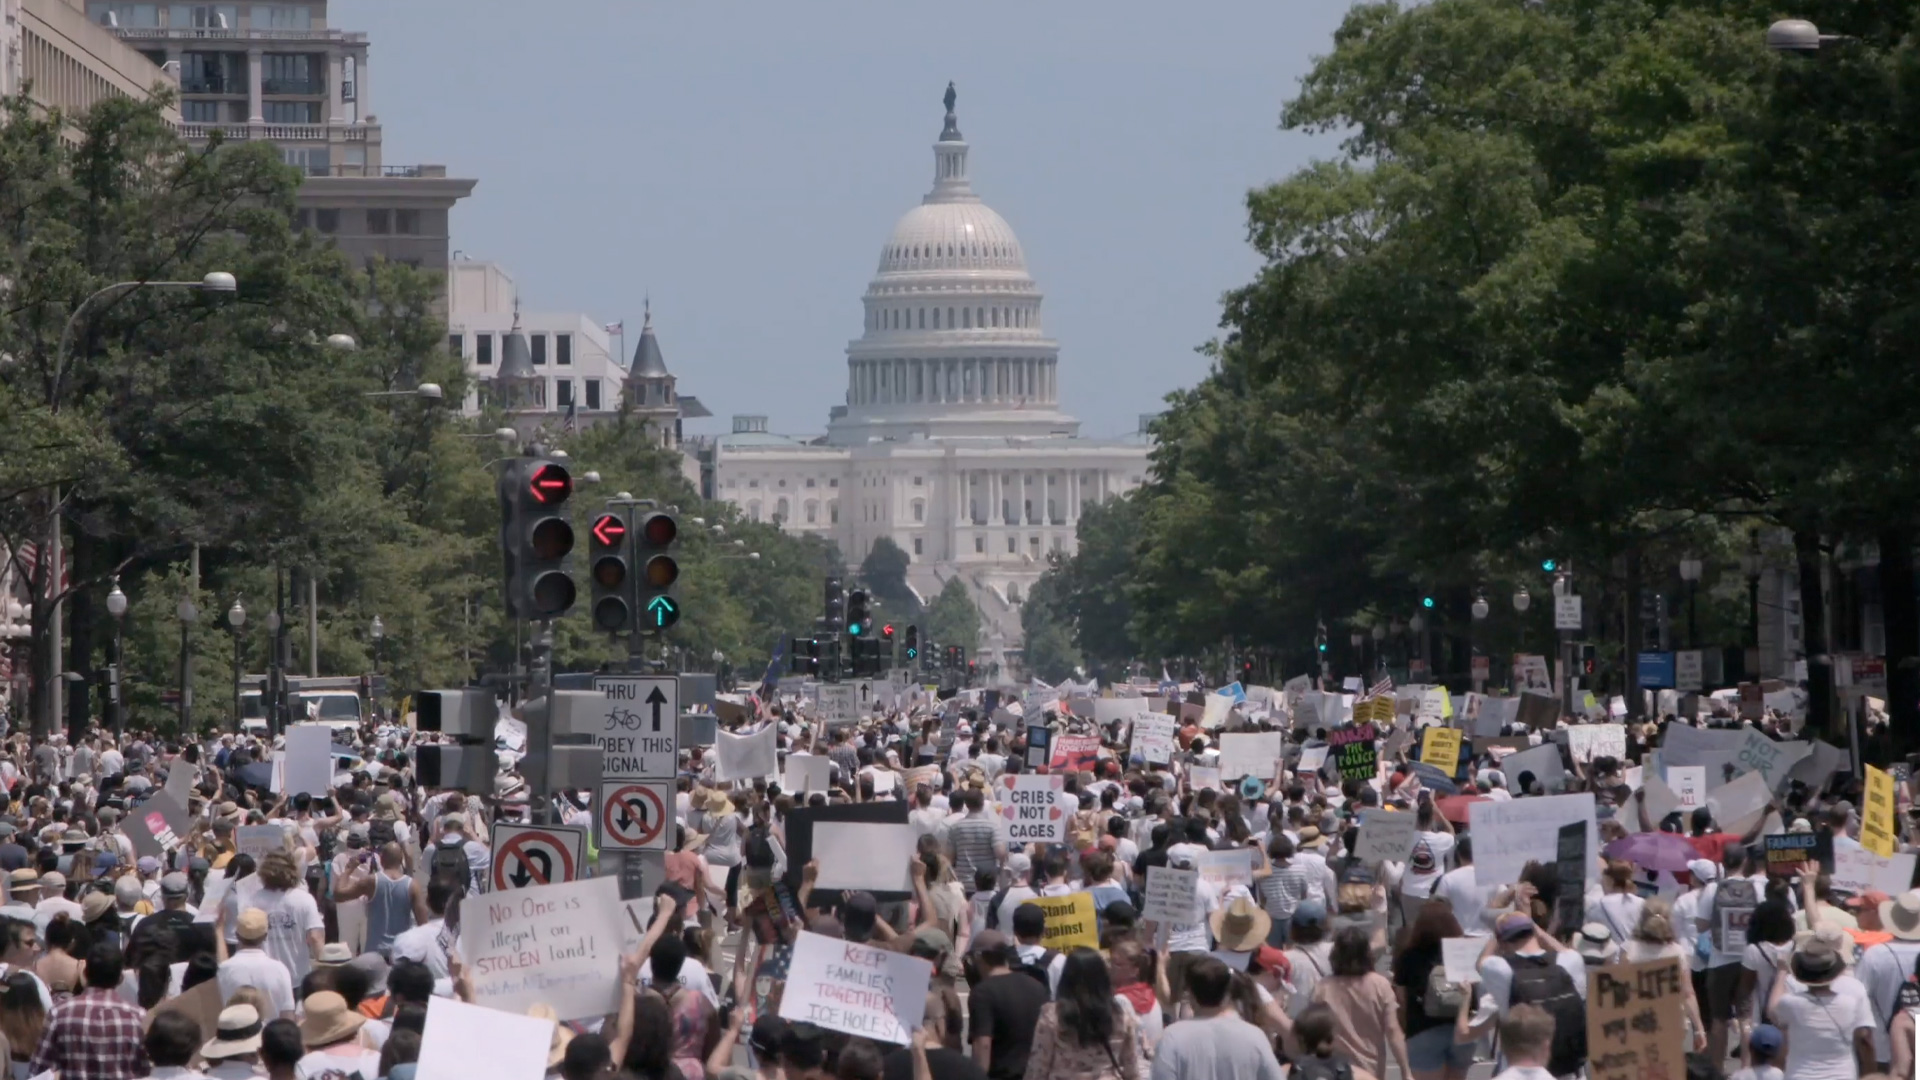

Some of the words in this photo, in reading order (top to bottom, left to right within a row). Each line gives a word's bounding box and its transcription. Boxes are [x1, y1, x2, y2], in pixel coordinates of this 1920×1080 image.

[598, 683, 637, 700] THRU
[597, 737, 636, 753] OBEY
[641, 737, 673, 753] THIS
[1344, 742, 1364, 755] THE
[1744, 733, 1783, 761] NOT
[1338, 751, 1374, 767] POLICE
[1011, 790, 1055, 804] CRIBS
[1019, 805, 1045, 820] NOT
[1009, 823, 1055, 838] CAGES
[1767, 834, 1817, 850] FAMILIES
[489, 902, 513, 926] No
[521, 896, 557, 919] One
[564, 896, 581, 910] is
[1042, 902, 1075, 918] Stand
[490, 924, 537, 953] illegal
[550, 925, 571, 938] on
[1045, 922, 1084, 940] gainst
[476, 949, 541, 976] STOLEN
[549, 935, 597, 962] land!
[844, 943, 887, 969] KEEP
[823, 964, 893, 994] FAMILIES
[805, 1002, 841, 1025] ICE
